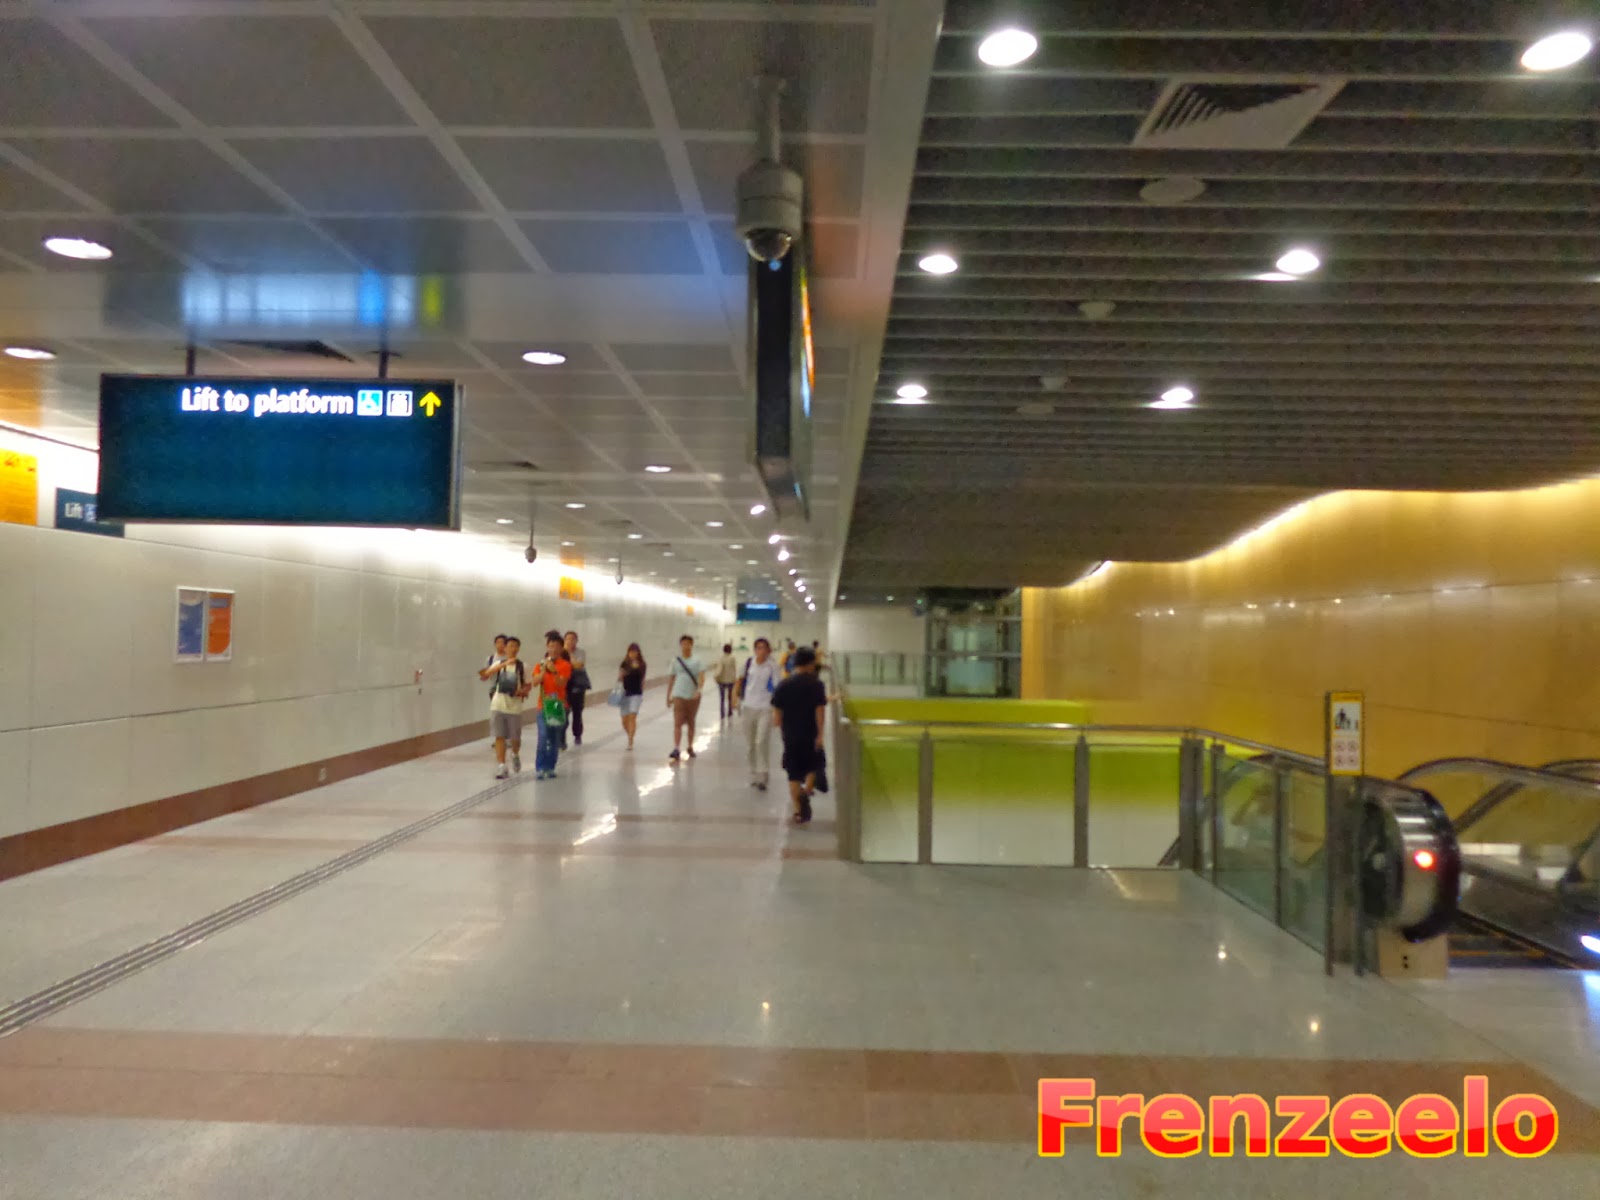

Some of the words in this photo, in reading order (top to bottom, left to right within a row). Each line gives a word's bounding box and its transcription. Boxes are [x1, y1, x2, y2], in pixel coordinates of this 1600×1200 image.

[181, 386, 220, 411] Lift
[223, 389, 250, 412] to
[254, 388, 354, 417] platform
[64, 502, 83, 519] Lift
